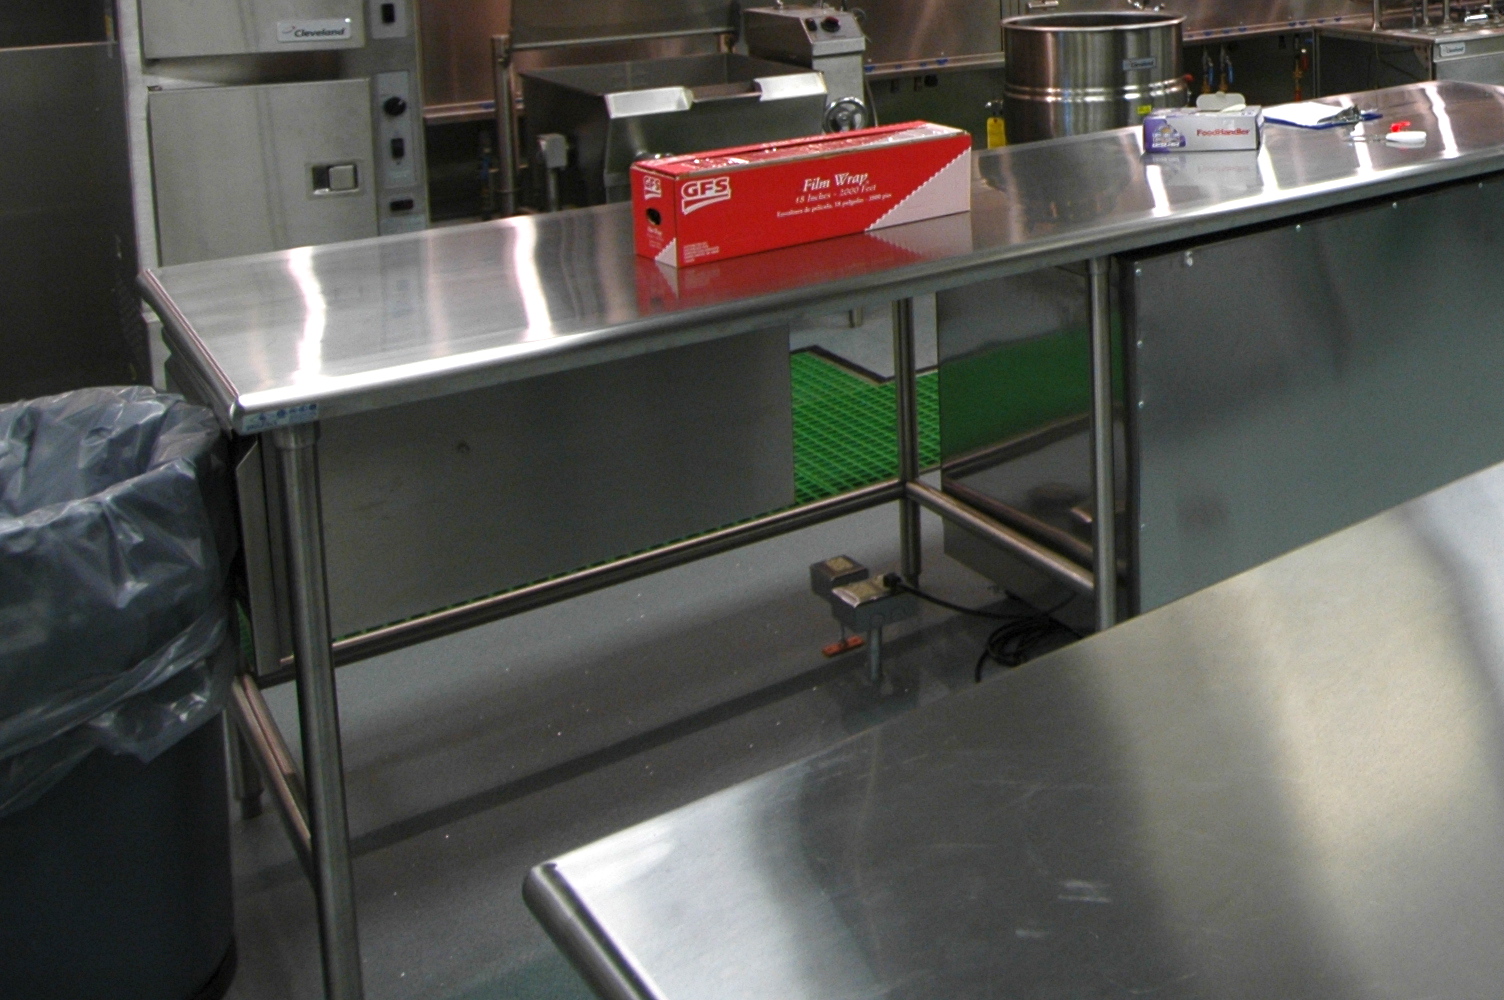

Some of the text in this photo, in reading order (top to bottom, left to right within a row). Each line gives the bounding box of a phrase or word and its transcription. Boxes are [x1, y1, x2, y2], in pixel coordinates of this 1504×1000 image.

[294, 27, 346, 38] Cleveland
[682, 176, 730, 197] GFS
[803, 172, 868, 192] Film Wrap
